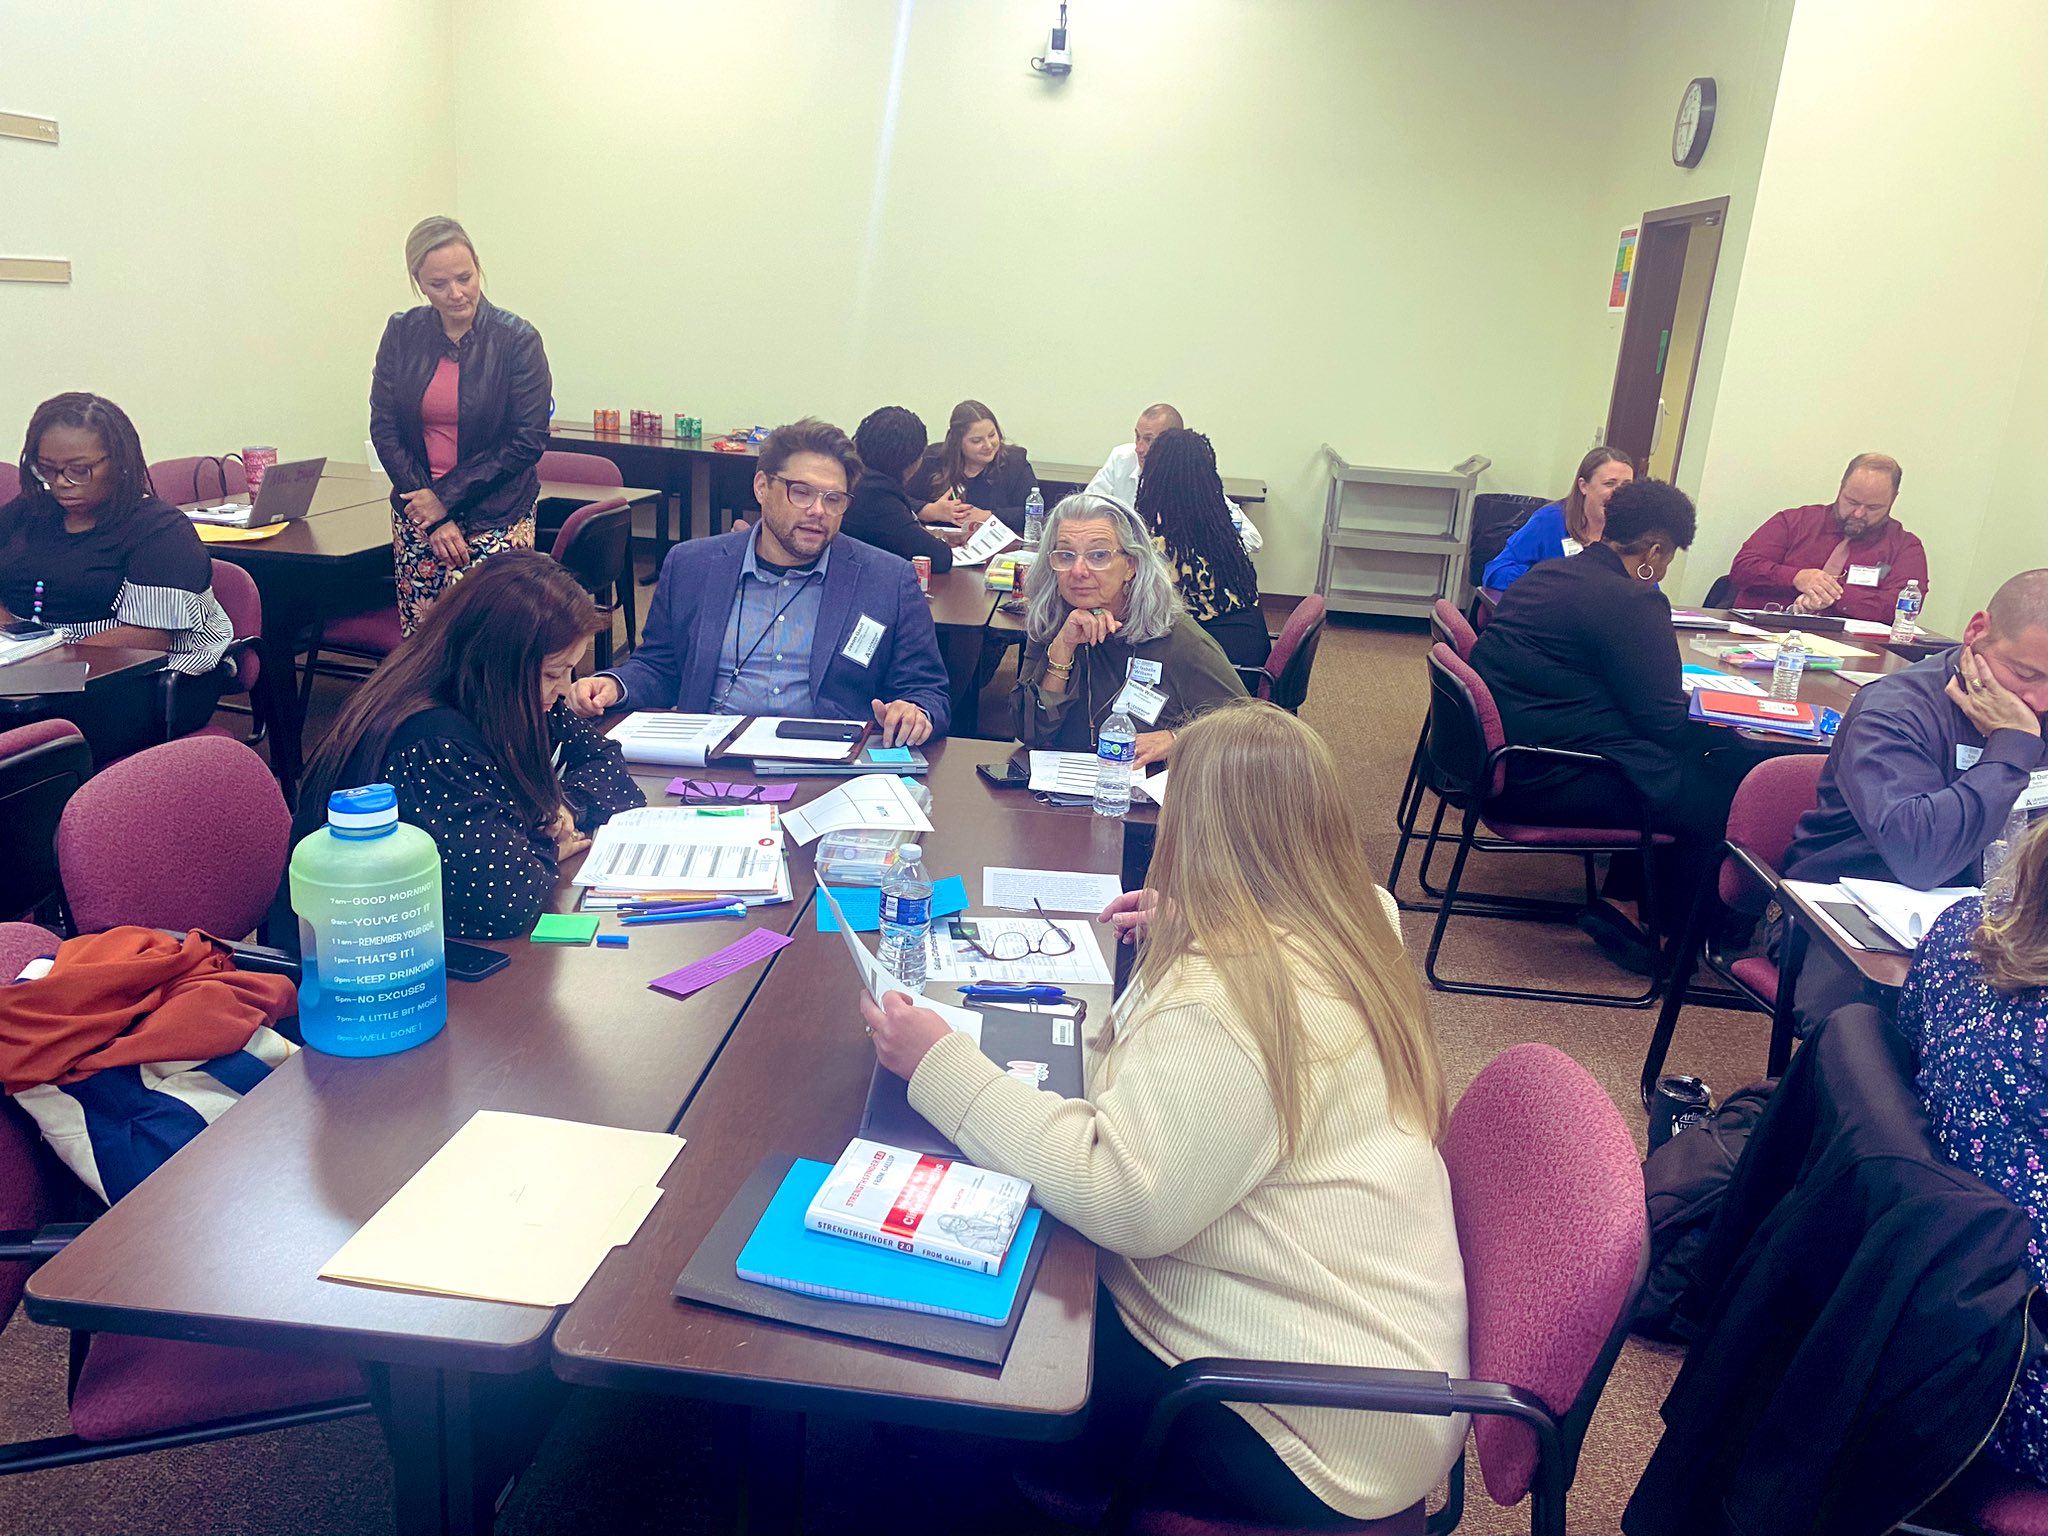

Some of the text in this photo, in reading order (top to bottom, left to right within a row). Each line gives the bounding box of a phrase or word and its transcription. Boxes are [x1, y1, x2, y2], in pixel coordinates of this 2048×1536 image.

[401, 907, 422, 920] GOT
[423, 903, 430, 912] IT
[403, 927, 422, 939] YOUR
[389, 958, 434, 980] DRINKING
[378, 982, 426, 1001] EXCUSES
[368, 1010, 399, 1022] LITTLE
[401, 1006, 415, 1016] BIT
[417, 995, 438, 1011] MORE
[817, 1221, 894, 1247] STRENGTHSFINDER
[922, 1249, 943, 1260] FROM
[944, 1255, 972, 1267] GALLUP
